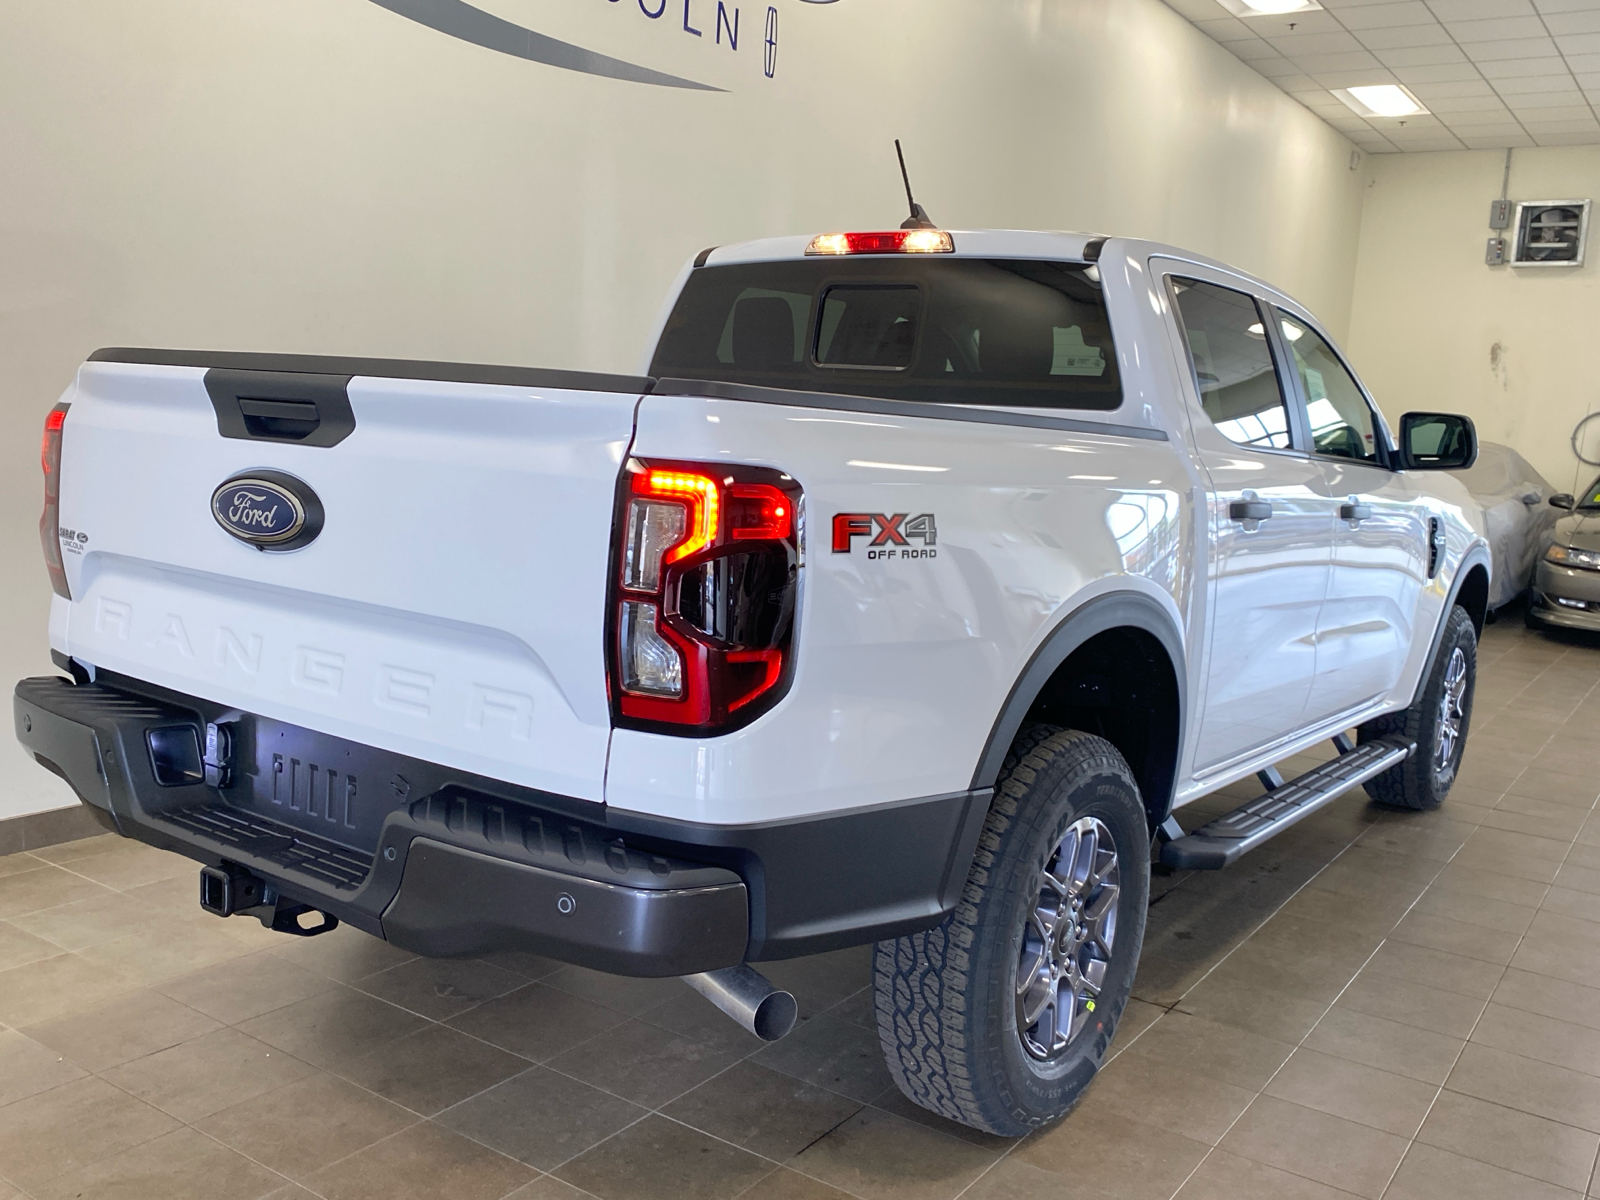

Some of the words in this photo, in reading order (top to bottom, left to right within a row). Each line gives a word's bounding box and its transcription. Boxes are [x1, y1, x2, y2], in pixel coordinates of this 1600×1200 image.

[228, 490, 279, 528] Ford
[62, 539, 85, 551] LINCOLN
[831, 512, 938, 554] FX4
[867, 550, 897, 560] OFF
[901, 549, 937, 559] ROAD
[94, 595, 536, 741] RANGER
